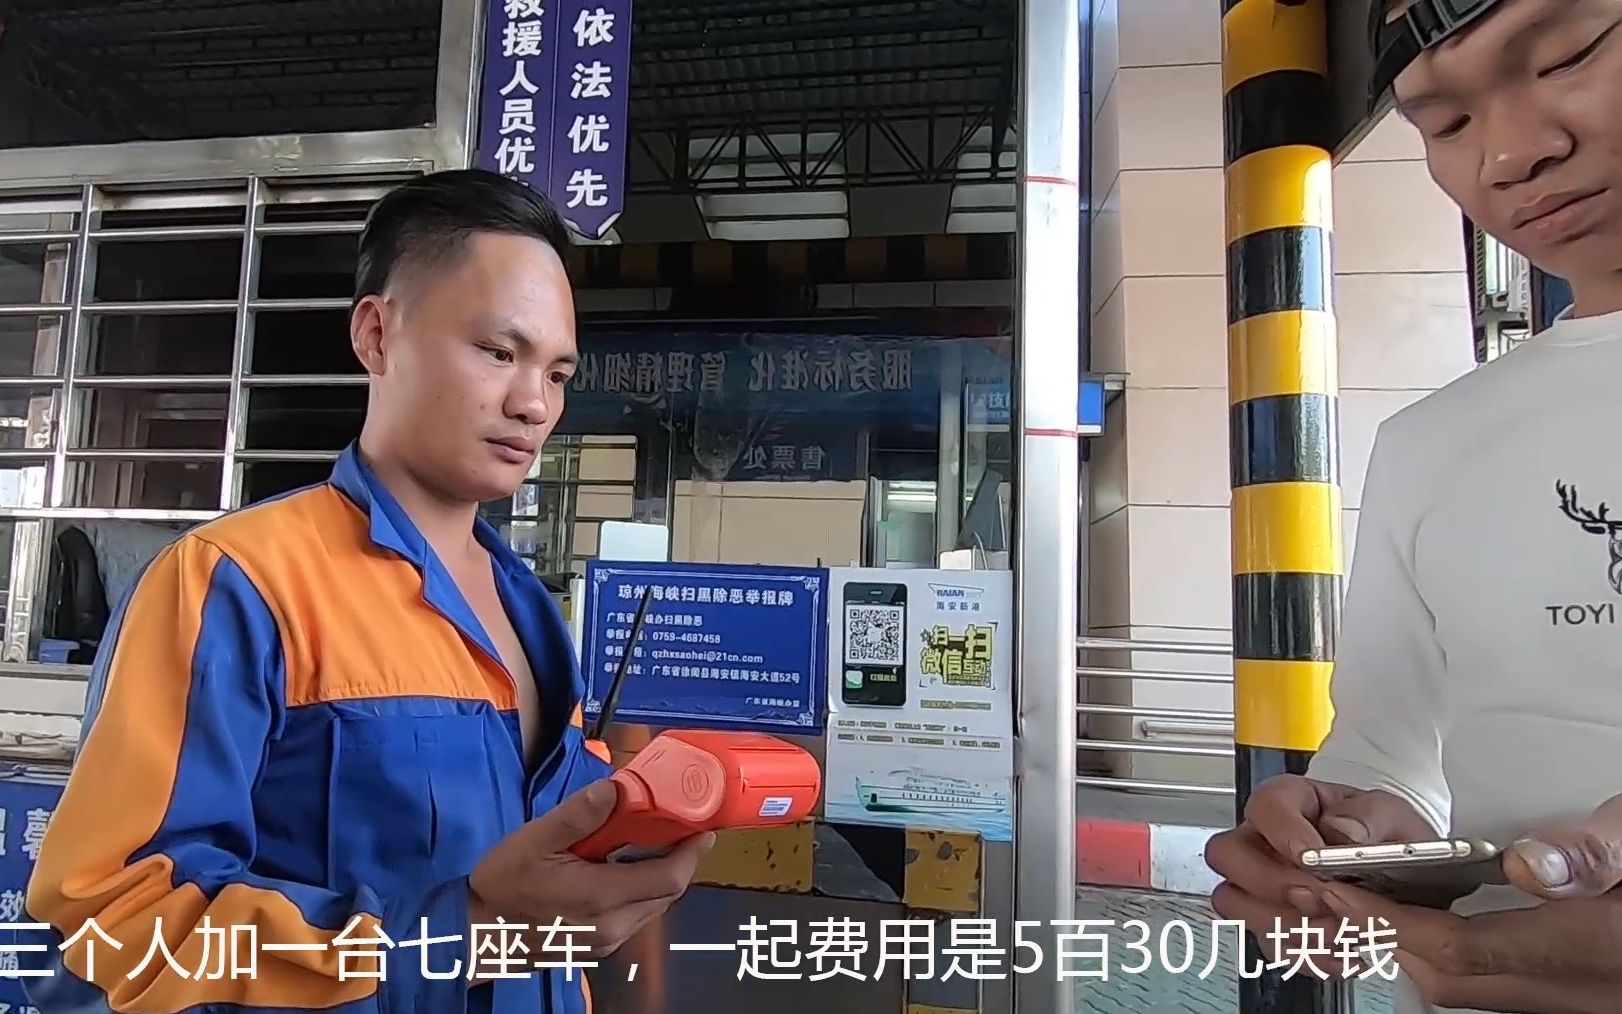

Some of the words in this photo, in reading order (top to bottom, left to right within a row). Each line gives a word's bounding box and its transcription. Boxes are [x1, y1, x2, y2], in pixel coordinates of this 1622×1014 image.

[494, 0, 544, 187] 救援人员优
[566, 8, 615, 208] 依法优先
[606, 612, 703, 626] 广东省峡办扫黑除恶
[1545, 603, 1614, 625] TOYI
